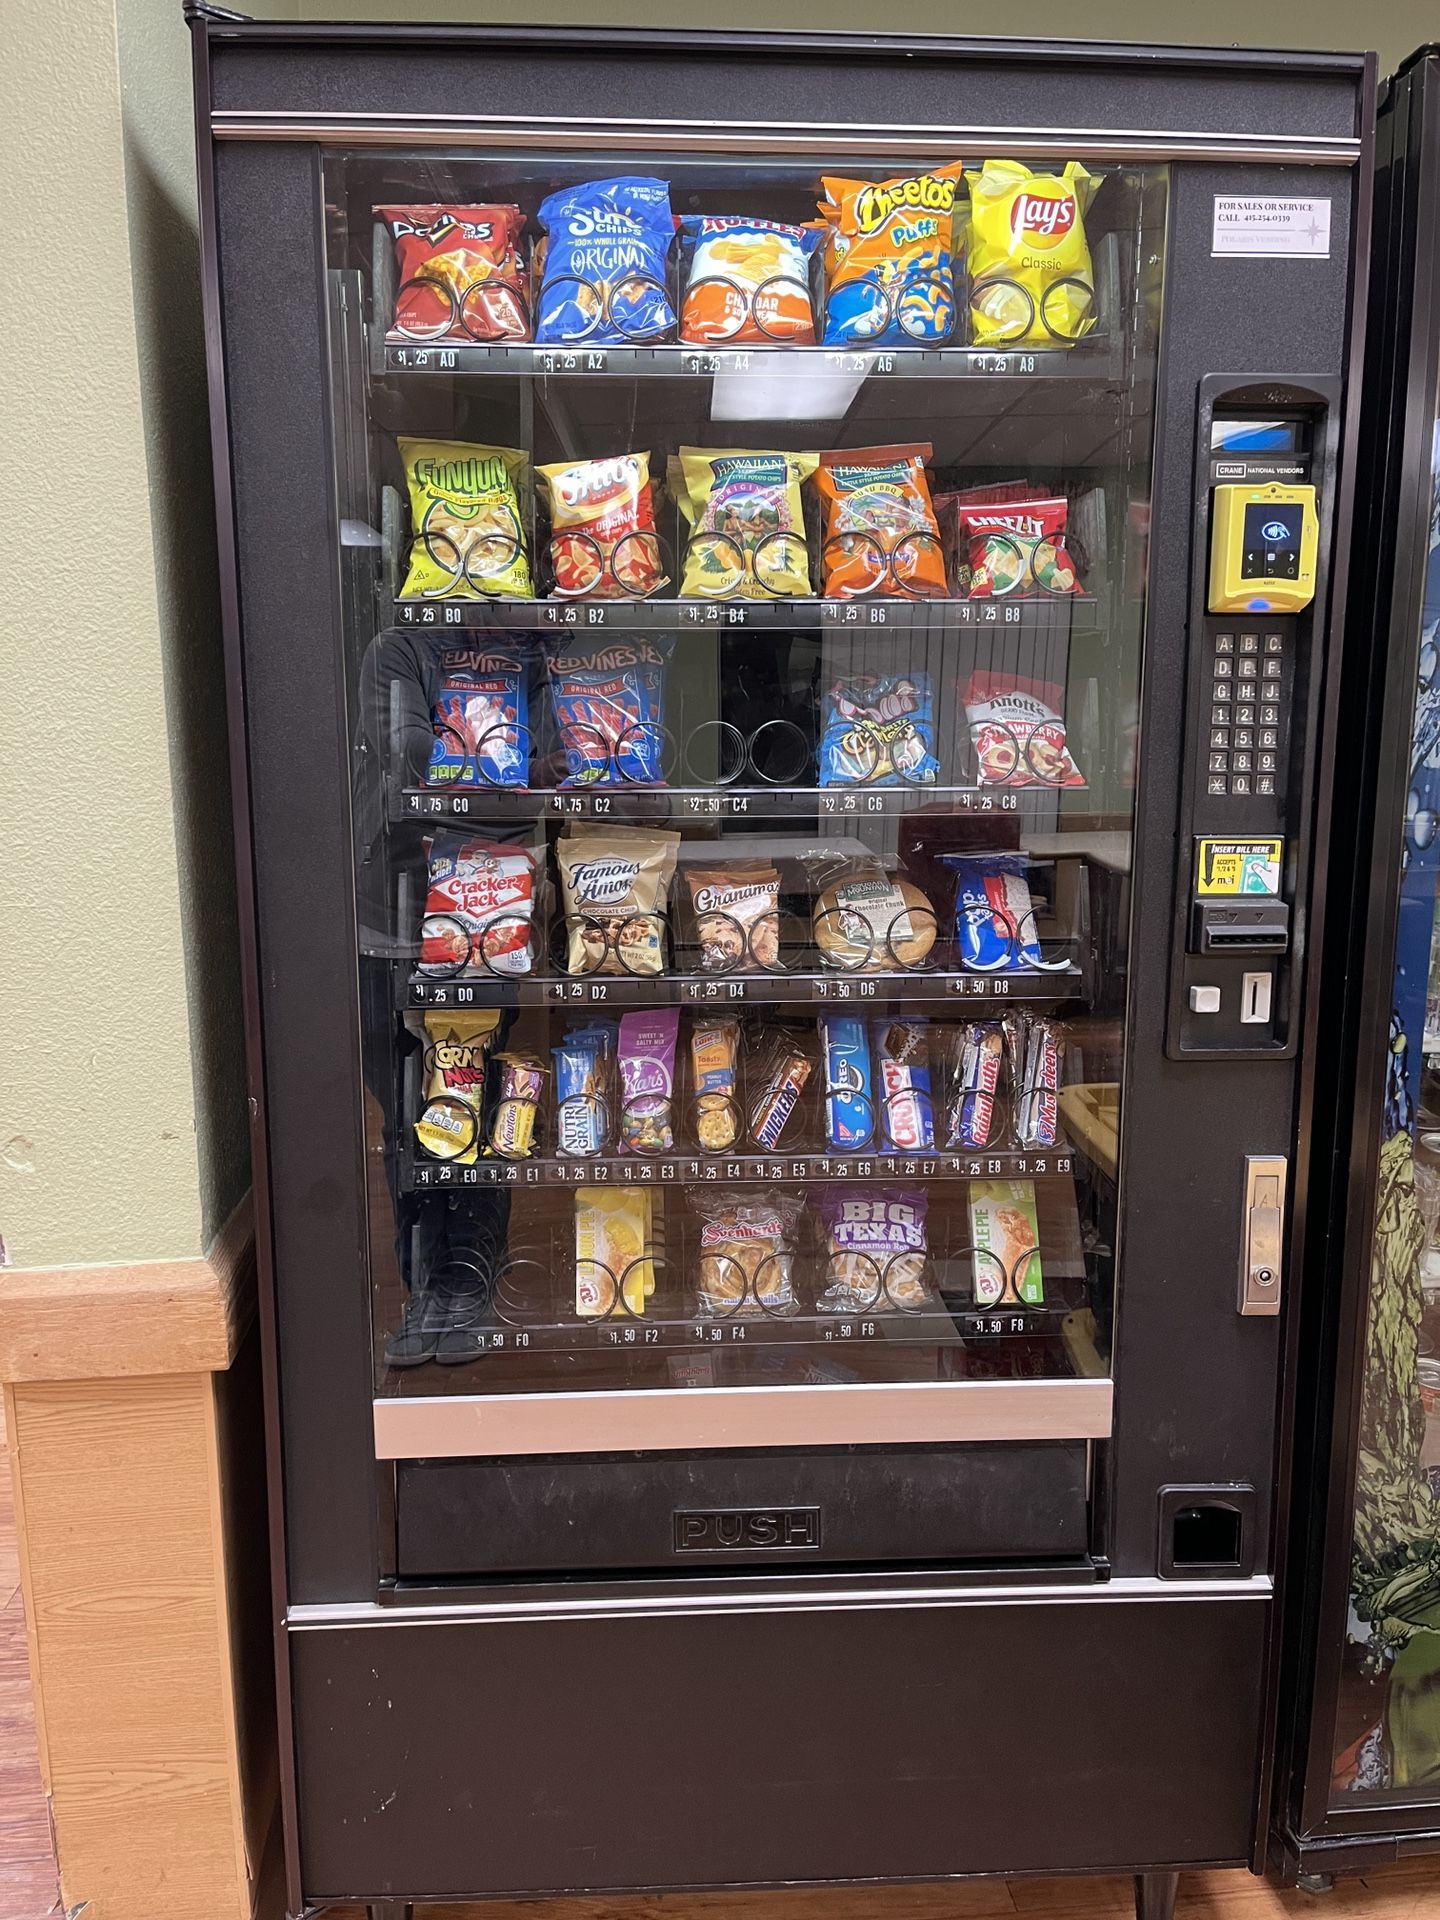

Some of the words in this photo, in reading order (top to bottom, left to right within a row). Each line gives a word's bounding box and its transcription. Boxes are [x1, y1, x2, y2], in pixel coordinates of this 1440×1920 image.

[857, 176, 954, 236] Cheetos
[1219, 202, 1236, 210] FOR
[1237, 203, 1263, 211] SALES
[1278, 203, 1314, 211] SERVICE
[1012, 194, 1074, 234] Lay's
[1218, 214, 1240, 222] CALL
[569, 206, 642, 237] Sun
[595, 223, 642, 236] CHIPS
[891, 218, 938, 247] Puffs
[1021, 257, 1062, 270] Classic
[440, 352, 455, 368] A0
[588, 353, 603, 369] A2
[735, 356, 749, 371] A4
[877, 357, 892, 372] A6
[1020, 359, 1034, 372] A8
[879, 485, 897, 494] BBQ
[596, 509, 640, 532] ORIGINAL
[513, 570, 526, 579] 180
[446, 609, 461, 623] B0
[589, 609, 604, 624] B2
[729, 608, 745, 623] B4
[871, 609, 886, 623] B6
[1005, 608, 1020, 622] B8
[1220, 638, 1228, 650] A
[1245, 638, 1252, 650] B
[1270, 638, 1278, 650] C
[579, 647, 638, 670] VINES
[1219, 662, 1227, 674] D
[1244, 662, 1251, 674] E
[1268, 662, 1276, 674] F
[450, 681, 484, 690] ORIGINAL
[485, 682, 498, 690] RED
[604, 683, 617, 692] RED
[1218, 685, 1226, 698] G
[1242, 685, 1250, 698] H
[1266, 685, 1274, 698] J
[991, 695, 1046, 718] Knott's
[1218, 709, 1224, 721] 1
[1241, 709, 1249, 720] 2
[1266, 709, 1273, 721] 3
[1215, 732, 1222, 744] 4
[1240, 732, 1247, 744] 5
[1264, 732, 1272, 744] 6
[1215, 756, 1222, 767] 7
[1238, 756, 1246, 768] 8
[1262, 756, 1270, 768] 9
[1237, 779, 1245, 790] 0
[453, 798, 469, 813] C0
[595, 797, 610, 813] C2
[732, 797, 748, 811] C4
[868, 797, 883, 811] C6
[1002, 795, 1017, 809] C8
[1211, 844, 1235, 854] INSERT
[1235, 846, 1251, 854] BILL
[1251, 845, 1271, 854] HERE
[568, 862, 641, 890] Famous
[448, 877, 517, 895] Cracker
[574, 879, 633, 905] Amos
[847, 885, 890, 896] MOUNTAIN
[457, 891, 499, 912] Jack
[591, 985, 607, 999] D2
[729, 984, 744, 998] D4
[861, 982, 875, 996] D6
[994, 980, 1009, 993] D8
[458, 987, 473, 1001] D0
[434, 1040, 480, 1070] CORN
[698, 1055, 721, 1064] Toasty
[443, 1066, 486, 1088] NUTS
[622, 1070, 664, 1096] Kar's
[839, 1058, 852, 1104] OREO
[759, 1081, 798, 1149] SNICKERS
[503, 1103, 517, 1151] Newtons
[565, 1106, 577, 1149] NUTRI
[576, 1104, 589, 1149] GRAIN
[1040, 1125, 1056, 1141] 3
[661, 1165, 674, 1179] E3
[727, 1164, 740, 1178] E4
[793, 1163, 806, 1177] E5
[858, 1162, 871, 1176] E6
[923, 1160, 936, 1174] E7
[988, 1159, 1001, 1173] E8
[1057, 1159, 1070, 1172] E9
[463, 1169, 477, 1182] E0
[526, 1169, 539, 1182] E1
[594, 1166, 608, 1180] E2
[842, 1201, 915, 1224] BIG
[975, 1208, 989, 1228] PIE
[834, 1221, 922, 1247] TEXAS
[862, 1322, 875, 1336] F6
[1011, 1318, 1024, 1331] F8
[516, 1333, 529, 1347] F0
[645, 1330, 658, 1343] F2
[732, 1326, 745, 1340] F4
[682, 1515, 813, 1546] PUSH
